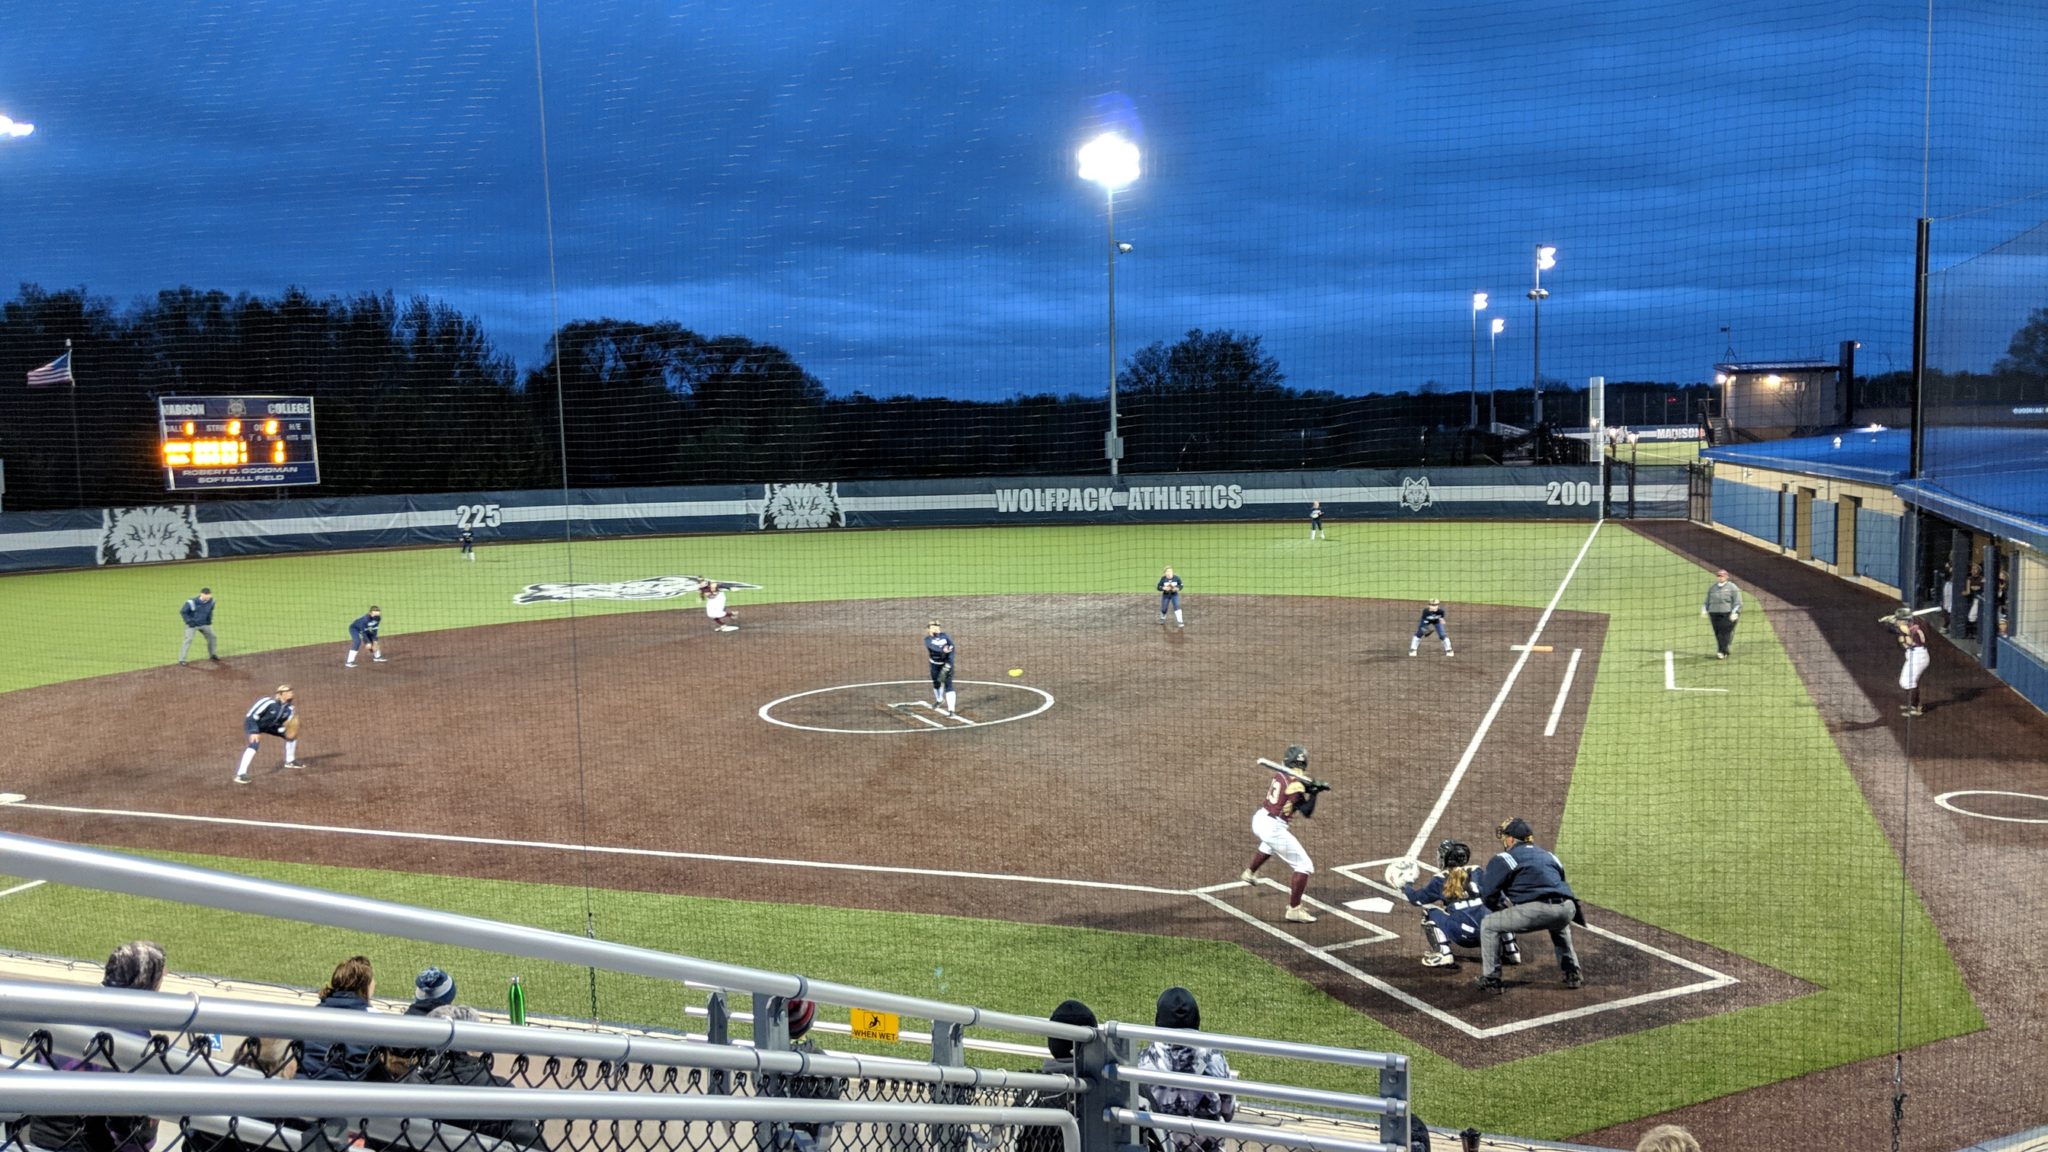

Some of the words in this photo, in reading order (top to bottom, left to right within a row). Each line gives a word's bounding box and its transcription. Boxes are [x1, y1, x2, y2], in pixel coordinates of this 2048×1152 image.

[267, 403, 310, 414] COLLEGE
[1657, 428, 1699, 439] MADISON
[996, 488, 1114, 512] WOLFPACK
[1128, 485, 1243, 510] ATHLETICS
[1547, 481, 1592, 505] 200
[456, 504, 502, 528] 225
[853, 1029, 877, 1039] WHEN
[878, 1032, 896, 1041] WET
